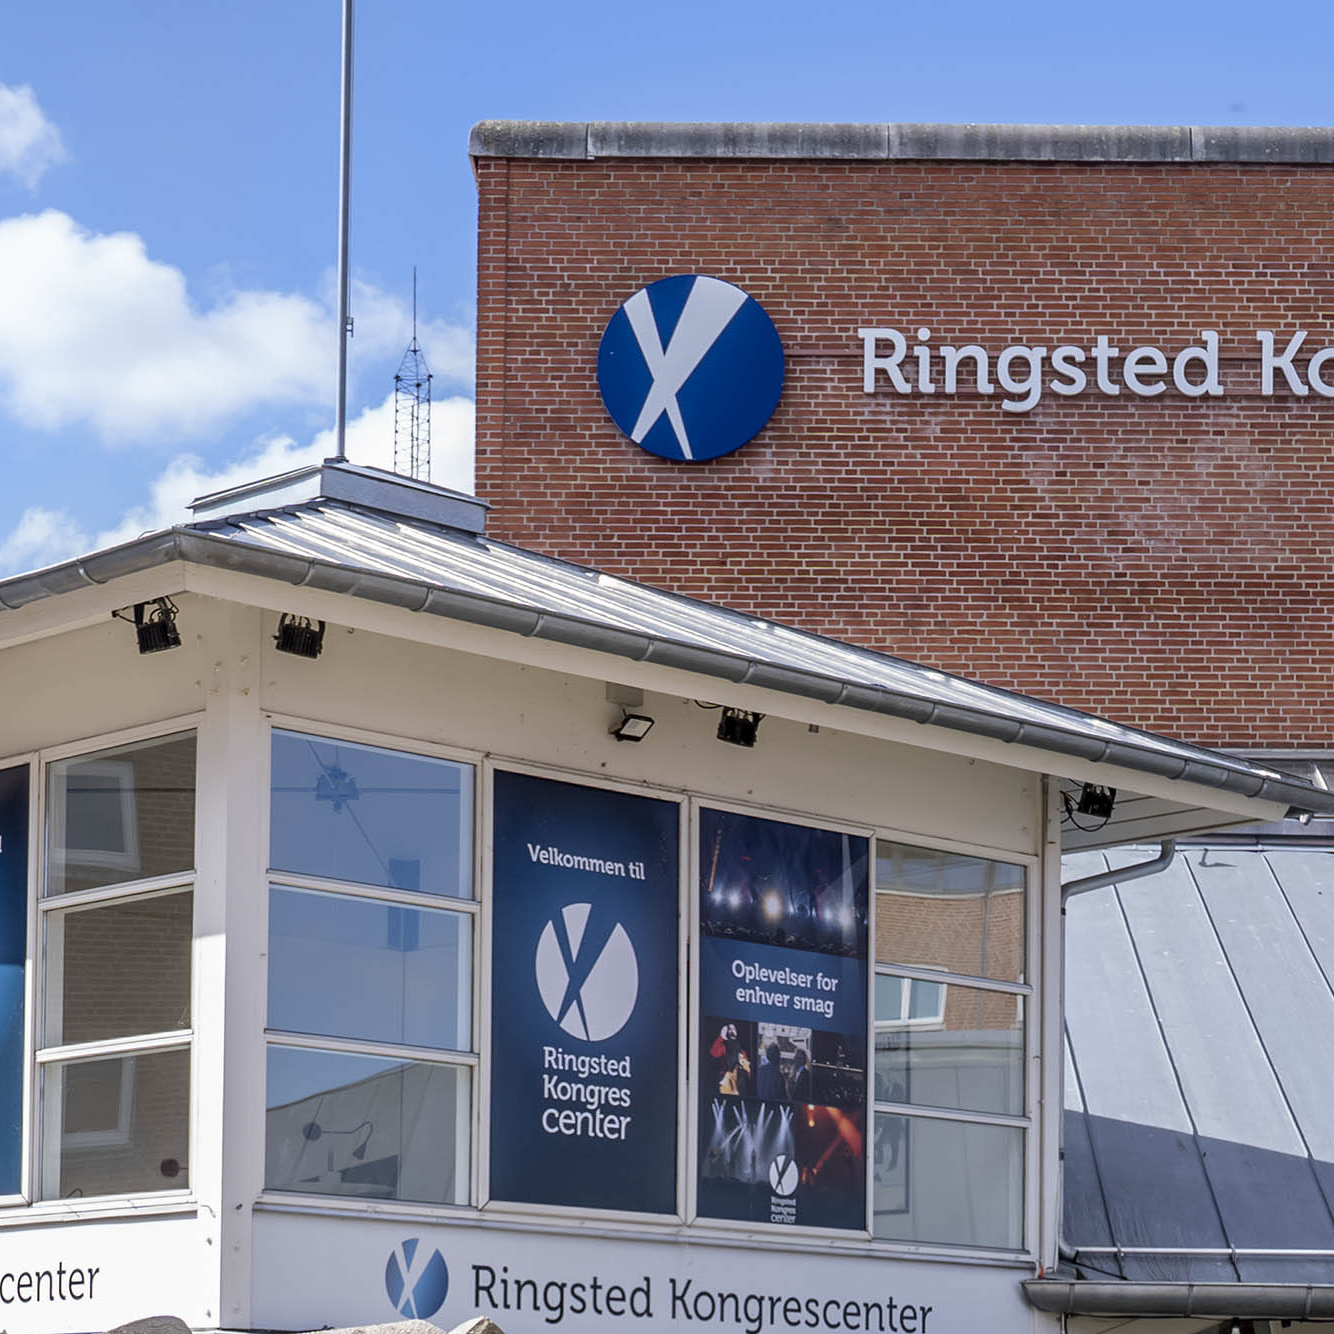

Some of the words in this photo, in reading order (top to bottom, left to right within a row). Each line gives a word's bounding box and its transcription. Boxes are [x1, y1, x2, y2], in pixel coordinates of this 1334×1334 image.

[857, 327, 1225, 414] Ringsted
[527, 843, 626, 877] Velkommen
[628, 862, 646, 880] til
[731, 960, 813, 988] Oplevelser
[816, 972, 839, 992] for
[736, 986, 790, 1008] enhver
[793, 995, 835, 1018] smag
[543, 1046, 632, 1078] Ringsted
[542, 1074, 632, 1109] Kongres
[542, 1108, 632, 1140] center
[770, 1214, 796, 1224] center
[471, 1264, 653, 1325] Ringsted
[669, 1277, 933, 1334] Kongrescenter
